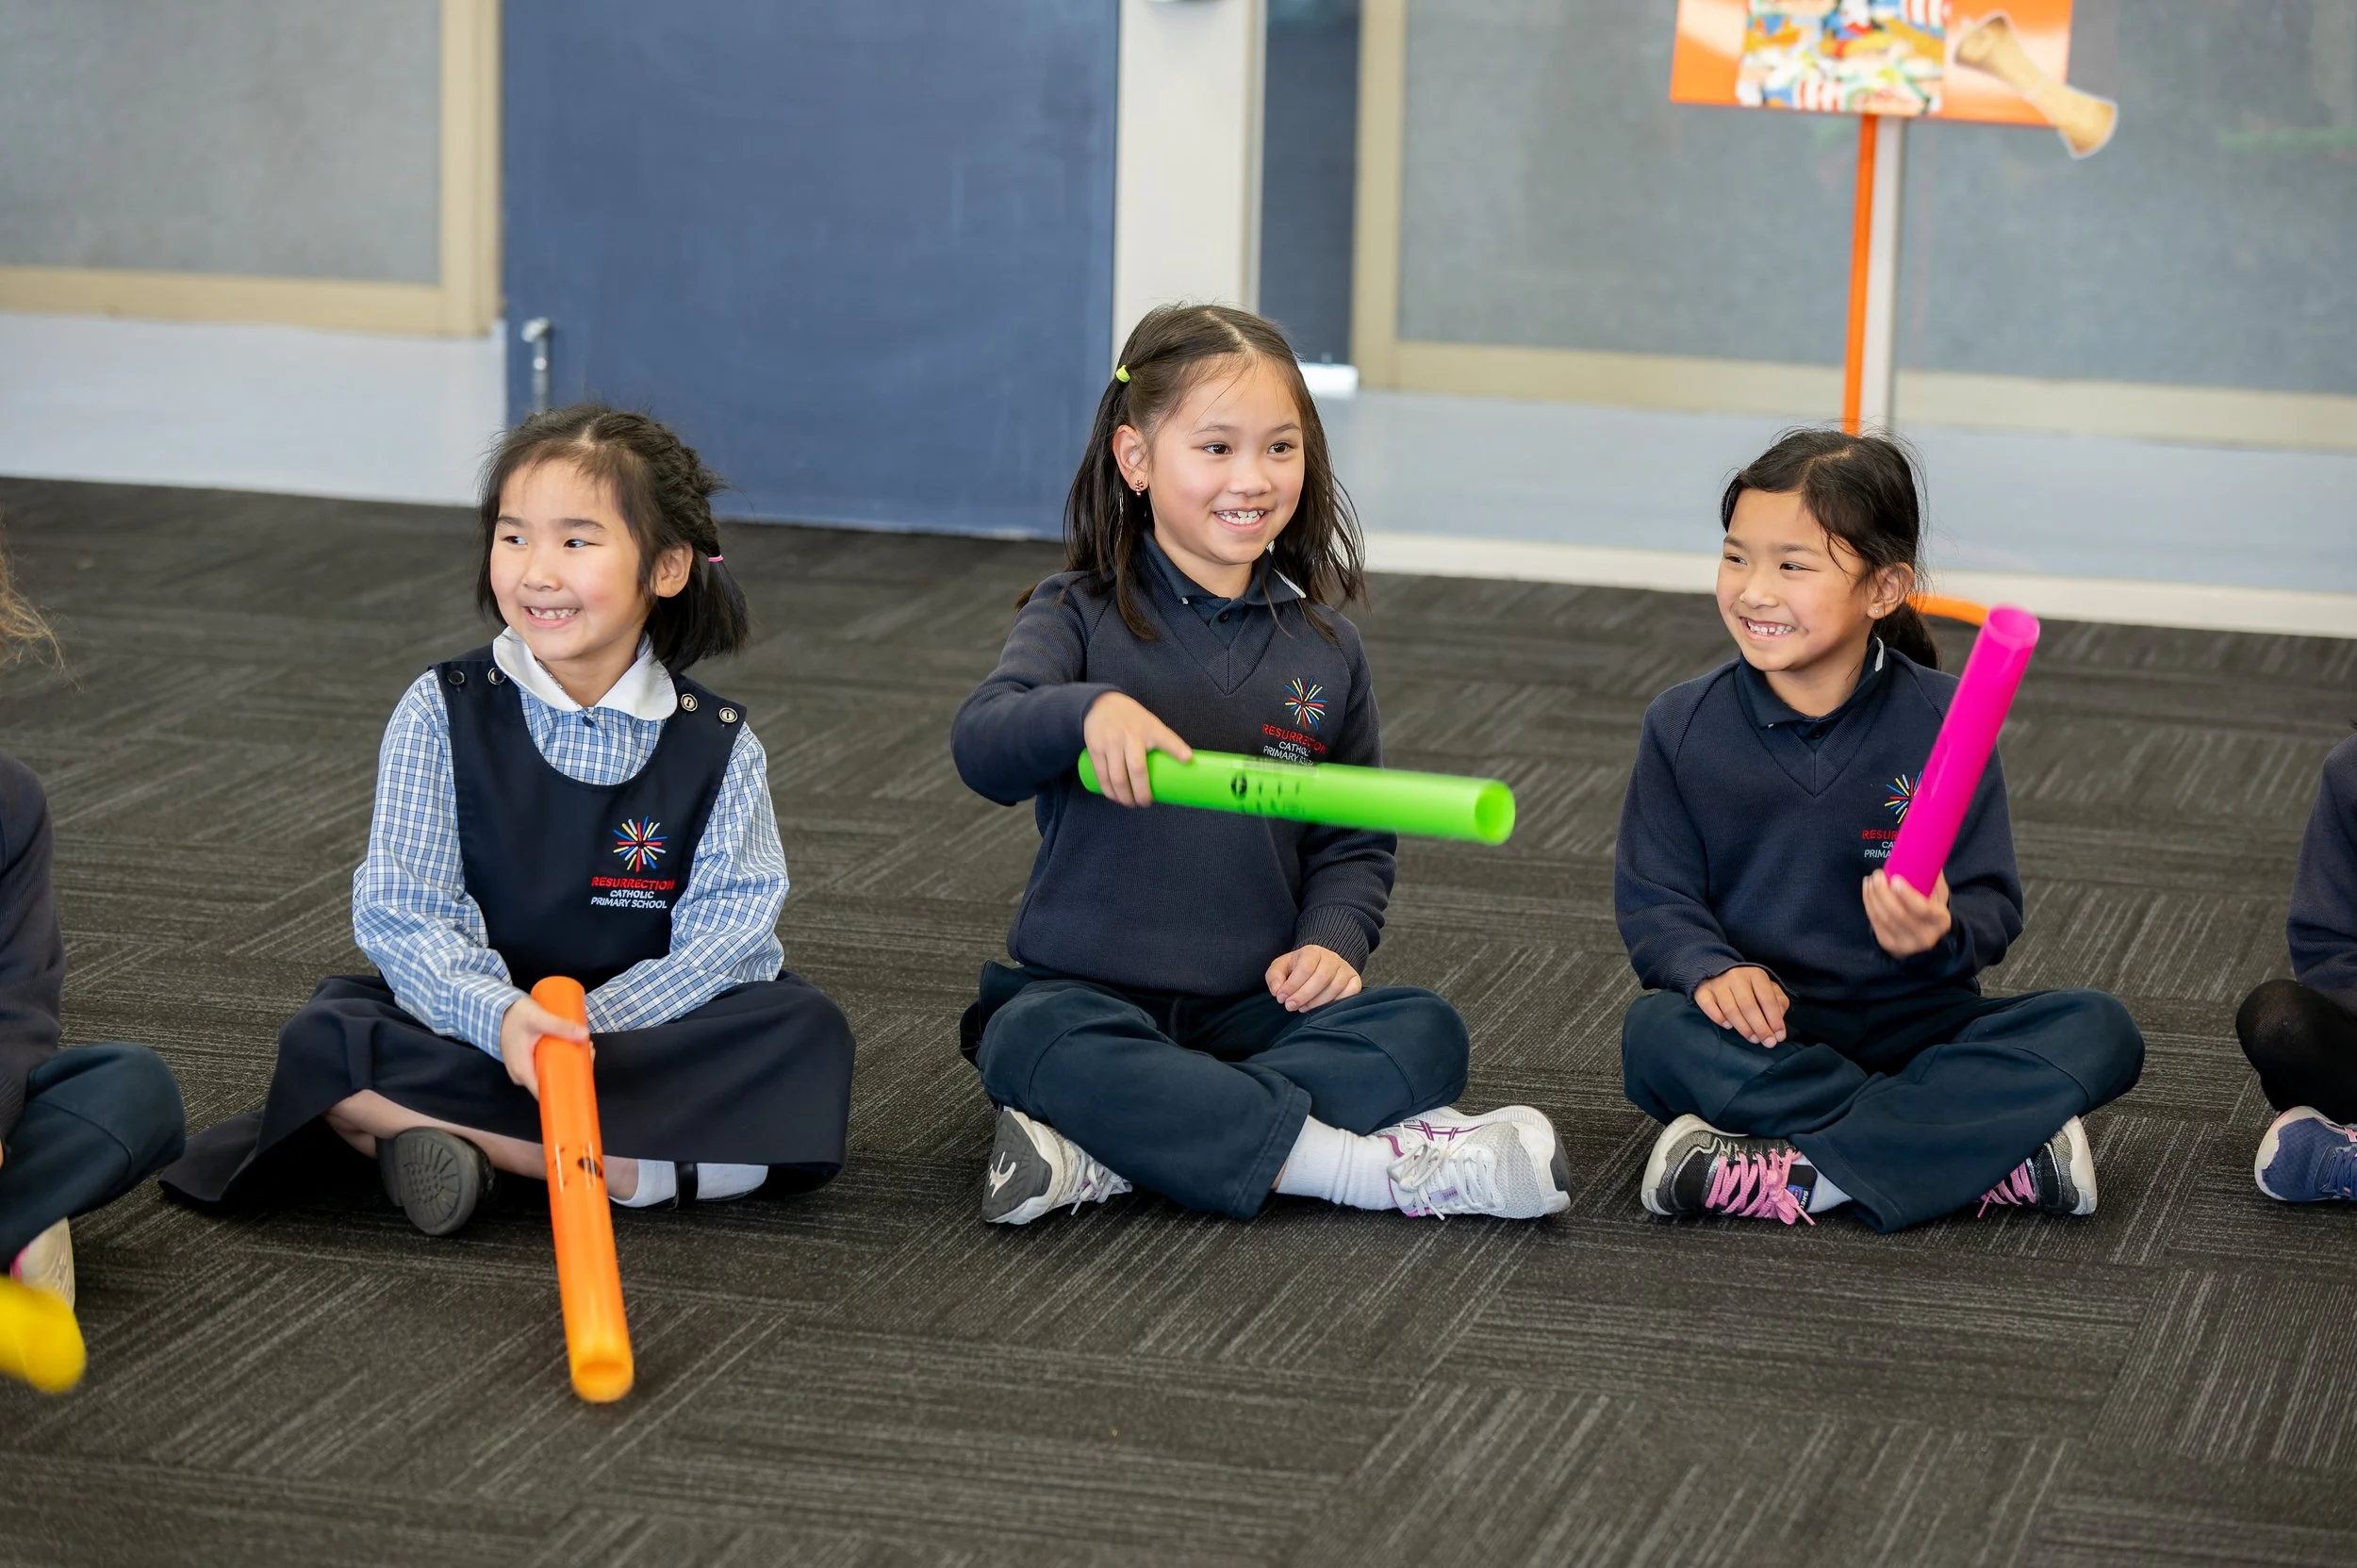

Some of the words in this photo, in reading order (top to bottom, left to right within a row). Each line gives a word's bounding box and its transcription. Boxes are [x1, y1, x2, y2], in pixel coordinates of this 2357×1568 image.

[1263, 745, 1299, 762] PRIMARY
[1278, 741, 1311, 757] CATHOL
[1864, 849, 1891, 859] PRIMA
[591, 876, 676, 891] RESURRECTION
[610, 889, 654, 900] CATHOLIC
[590, 897, 631, 907] PRIMARY
[631, 900, 668, 909] SCHOOL
